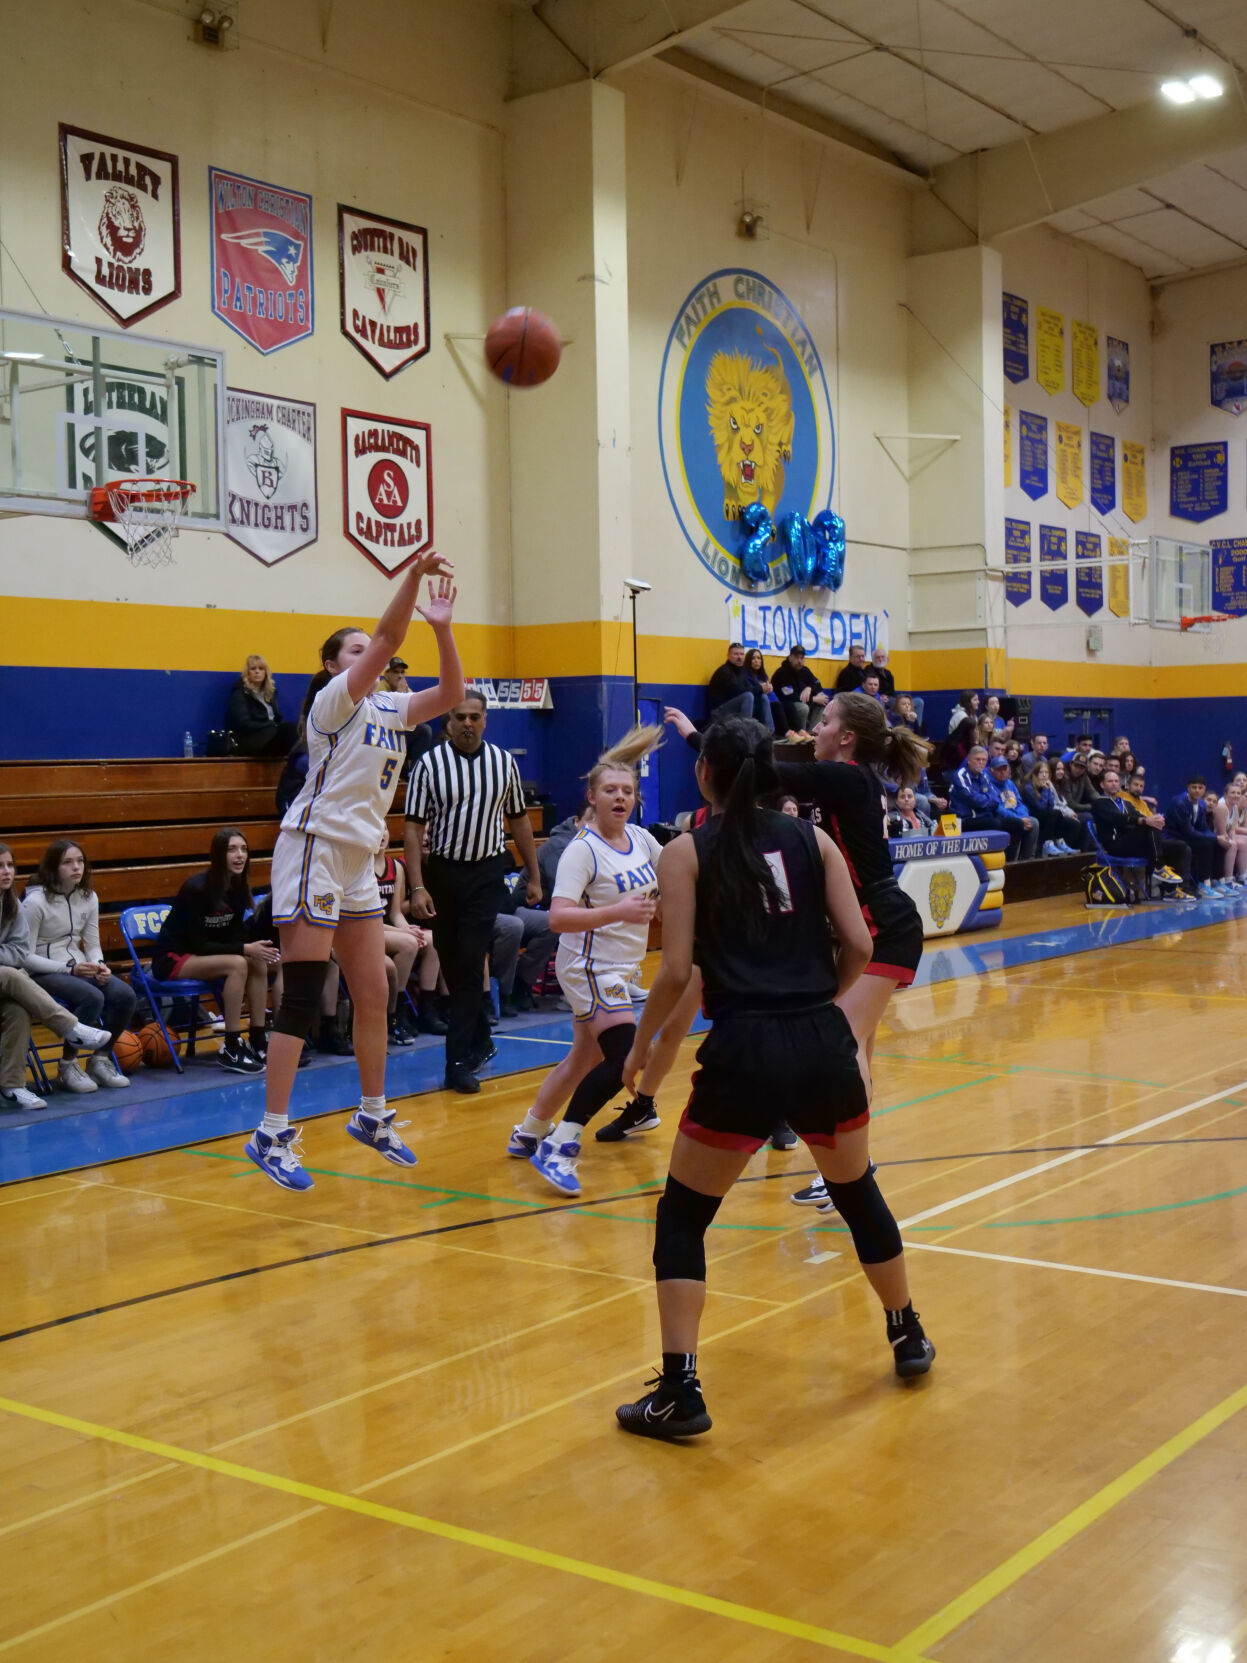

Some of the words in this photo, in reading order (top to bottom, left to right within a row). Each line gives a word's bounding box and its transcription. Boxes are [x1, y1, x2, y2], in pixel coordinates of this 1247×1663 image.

[80, 152, 162, 202] VALLEY
[215, 178, 255, 213] WILTON
[256, 190, 307, 236] CHRISTIAN
[350, 227, 395, 256] COUNTRY
[95, 256, 153, 296] LIONS
[220, 268, 306, 326] PATRIOTS
[352, 308, 420, 350] CAVALIERS
[675, 282, 722, 352] FAITH
[733, 275, 820, 379] CHRISTIAN
[82, 381, 168, 427] LTHERAN
[276, 404, 313, 444] CHARTER
[354, 428, 421, 469] SACRAMENTO
[261, 469, 274, 488] B
[228, 492, 310, 533] KNIGHTS
[355, 511, 422, 547] CAPITALS
[741, 603, 820, 656] LION'S
[829, 610, 878, 657] DEN
[361, 721, 407, 753] FAIT
[379, 757, 399, 790] 5
[894, 842, 924, 860] HOME
[925, 841, 939, 856] OF
[941, 839, 961, 854] THE
[962, 837, 989, 852] LIONS
[612, 860, 657, 895] FAIT
[313, 894, 333, 916] FCS
